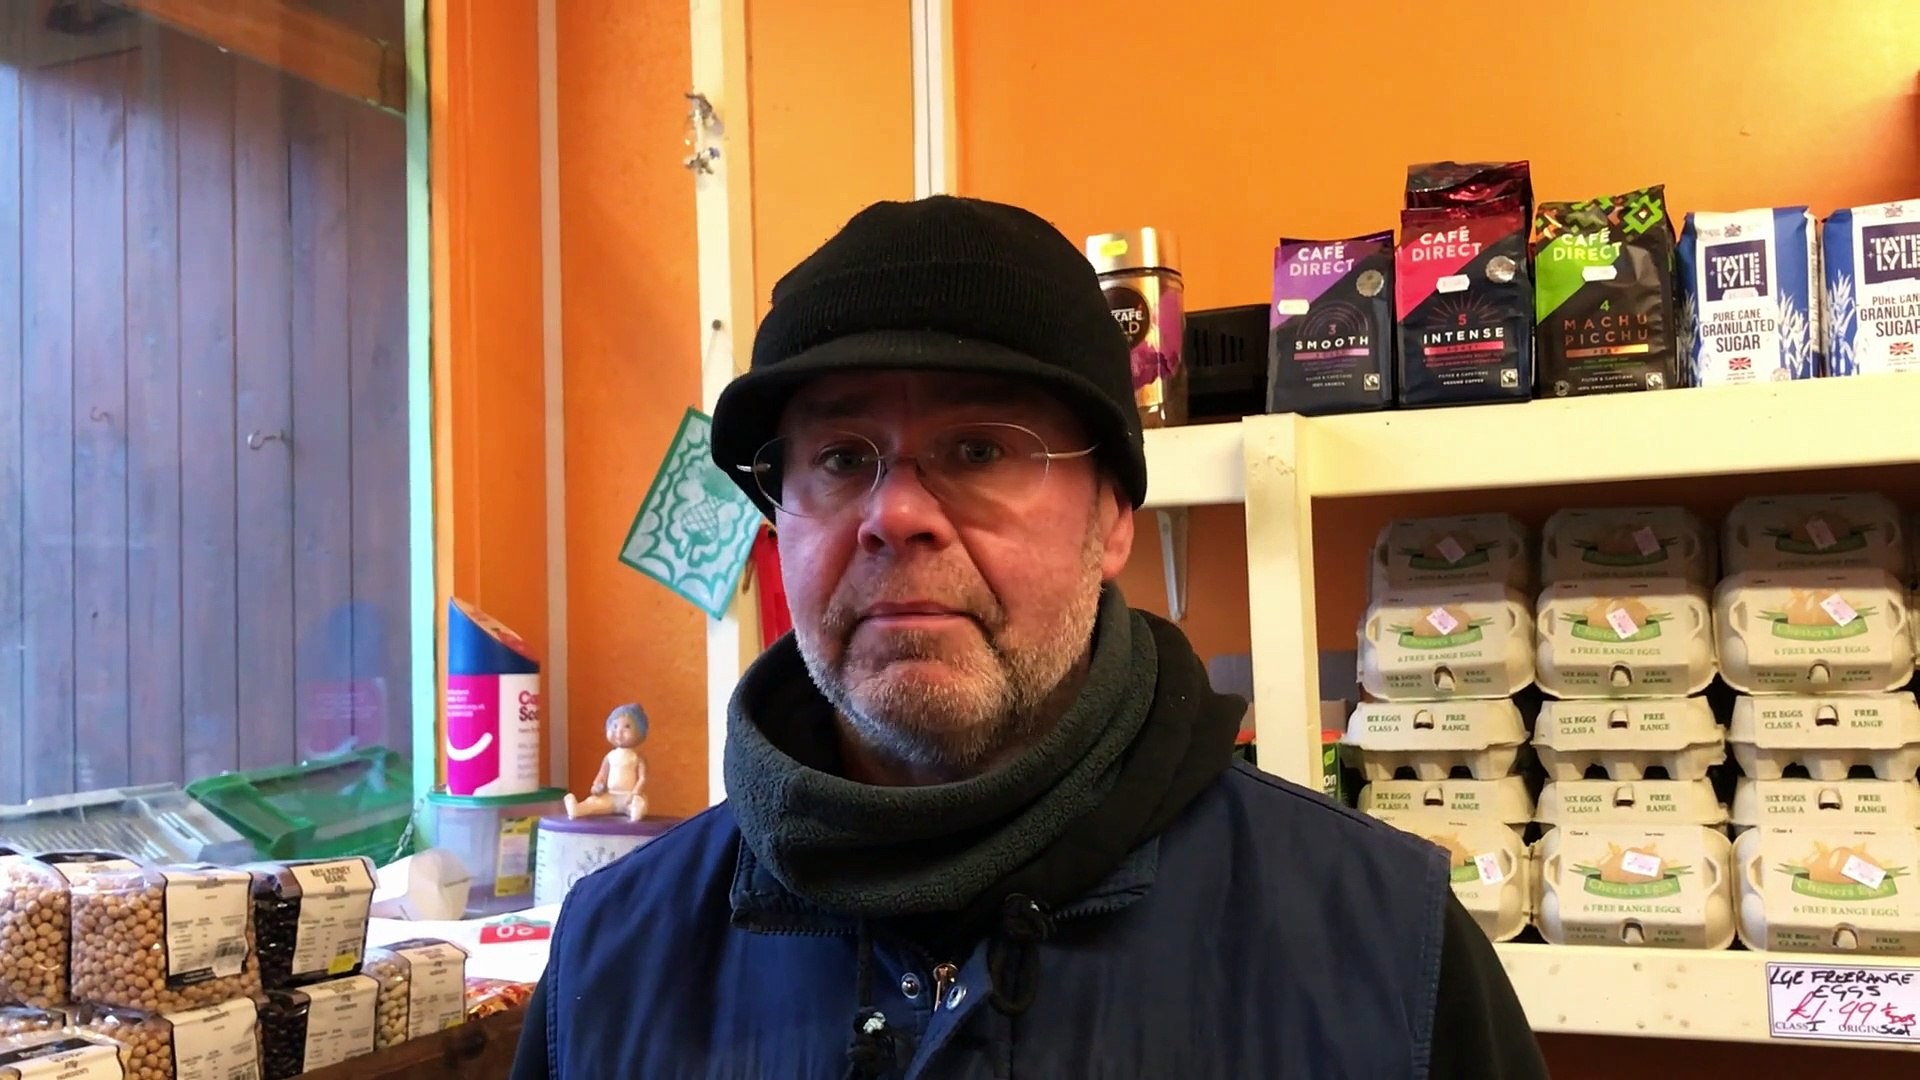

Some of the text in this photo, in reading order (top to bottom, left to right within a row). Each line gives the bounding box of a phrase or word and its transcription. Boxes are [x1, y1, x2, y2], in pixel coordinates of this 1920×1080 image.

[1420, 226, 1470, 245] CAFÉ
[1561, 227, 1611, 248] CAFÉ
[1298, 241, 1345, 261] CAFÉ
[1412, 242, 1482, 262] DIRECT
[1553, 242, 1622, 262] DIRECT
[1289, 258, 1355, 276] DIRECT
[1711, 252, 1760, 272] TATE
[1717, 270, 1760, 288] LYLE
[1600, 300, 1610, 311] 4
[1872, 296, 1897, 306] PURE
[1713, 308, 1761, 321] PURE CANE
[1860, 304, 1920, 321] GRANULAT
[1458, 313, 1468, 326] 5
[1564, 313, 1648, 331] MACHU
[1328, 323, 1337, 335] 3
[1703, 319, 1775, 337] GRANULATED
[1424, 327, 1504, 345] INTENSE
[1565, 329, 1648, 346] PICCHU
[1295, 336, 1369, 350] SMOOTH
[1716, 334, 1761, 353] SUGAR
[1381, 714, 1401, 722] EGGS
[1762, 710, 1803, 719] SIX EGGS
[1854, 709, 1879, 717] FREE
[1559, 716, 1573, 724] SIX
[1851, 720, 1883, 728] RANGE
[1368, 724, 1392, 732] CLASS
[1561, 726, 1587, 734] CLASS
[1640, 723, 1670, 731] RANGE
[1646, 804, 1677, 812] RANGE
[1768, 806, 1796, 814] CLASS
[1591, 903, 1616, 913] FREE
[1618, 904, 1653, 914] RANGE
[1655, 905, 1683, 914] EGGS
[1802, 905, 1829, 915] FREE
[1830, 906, 1869, 917] RANGE
[1871, 908, 1900, 918] EGGS
[1770, 967, 1804, 990] LGE
[1813, 984, 1881, 1002] EGGS
[1786, 991, 1877, 1028] £1.99
[1775, 1021, 1808, 1031] CLASS
[1838, 1022, 1879, 1034] ORIGIN
